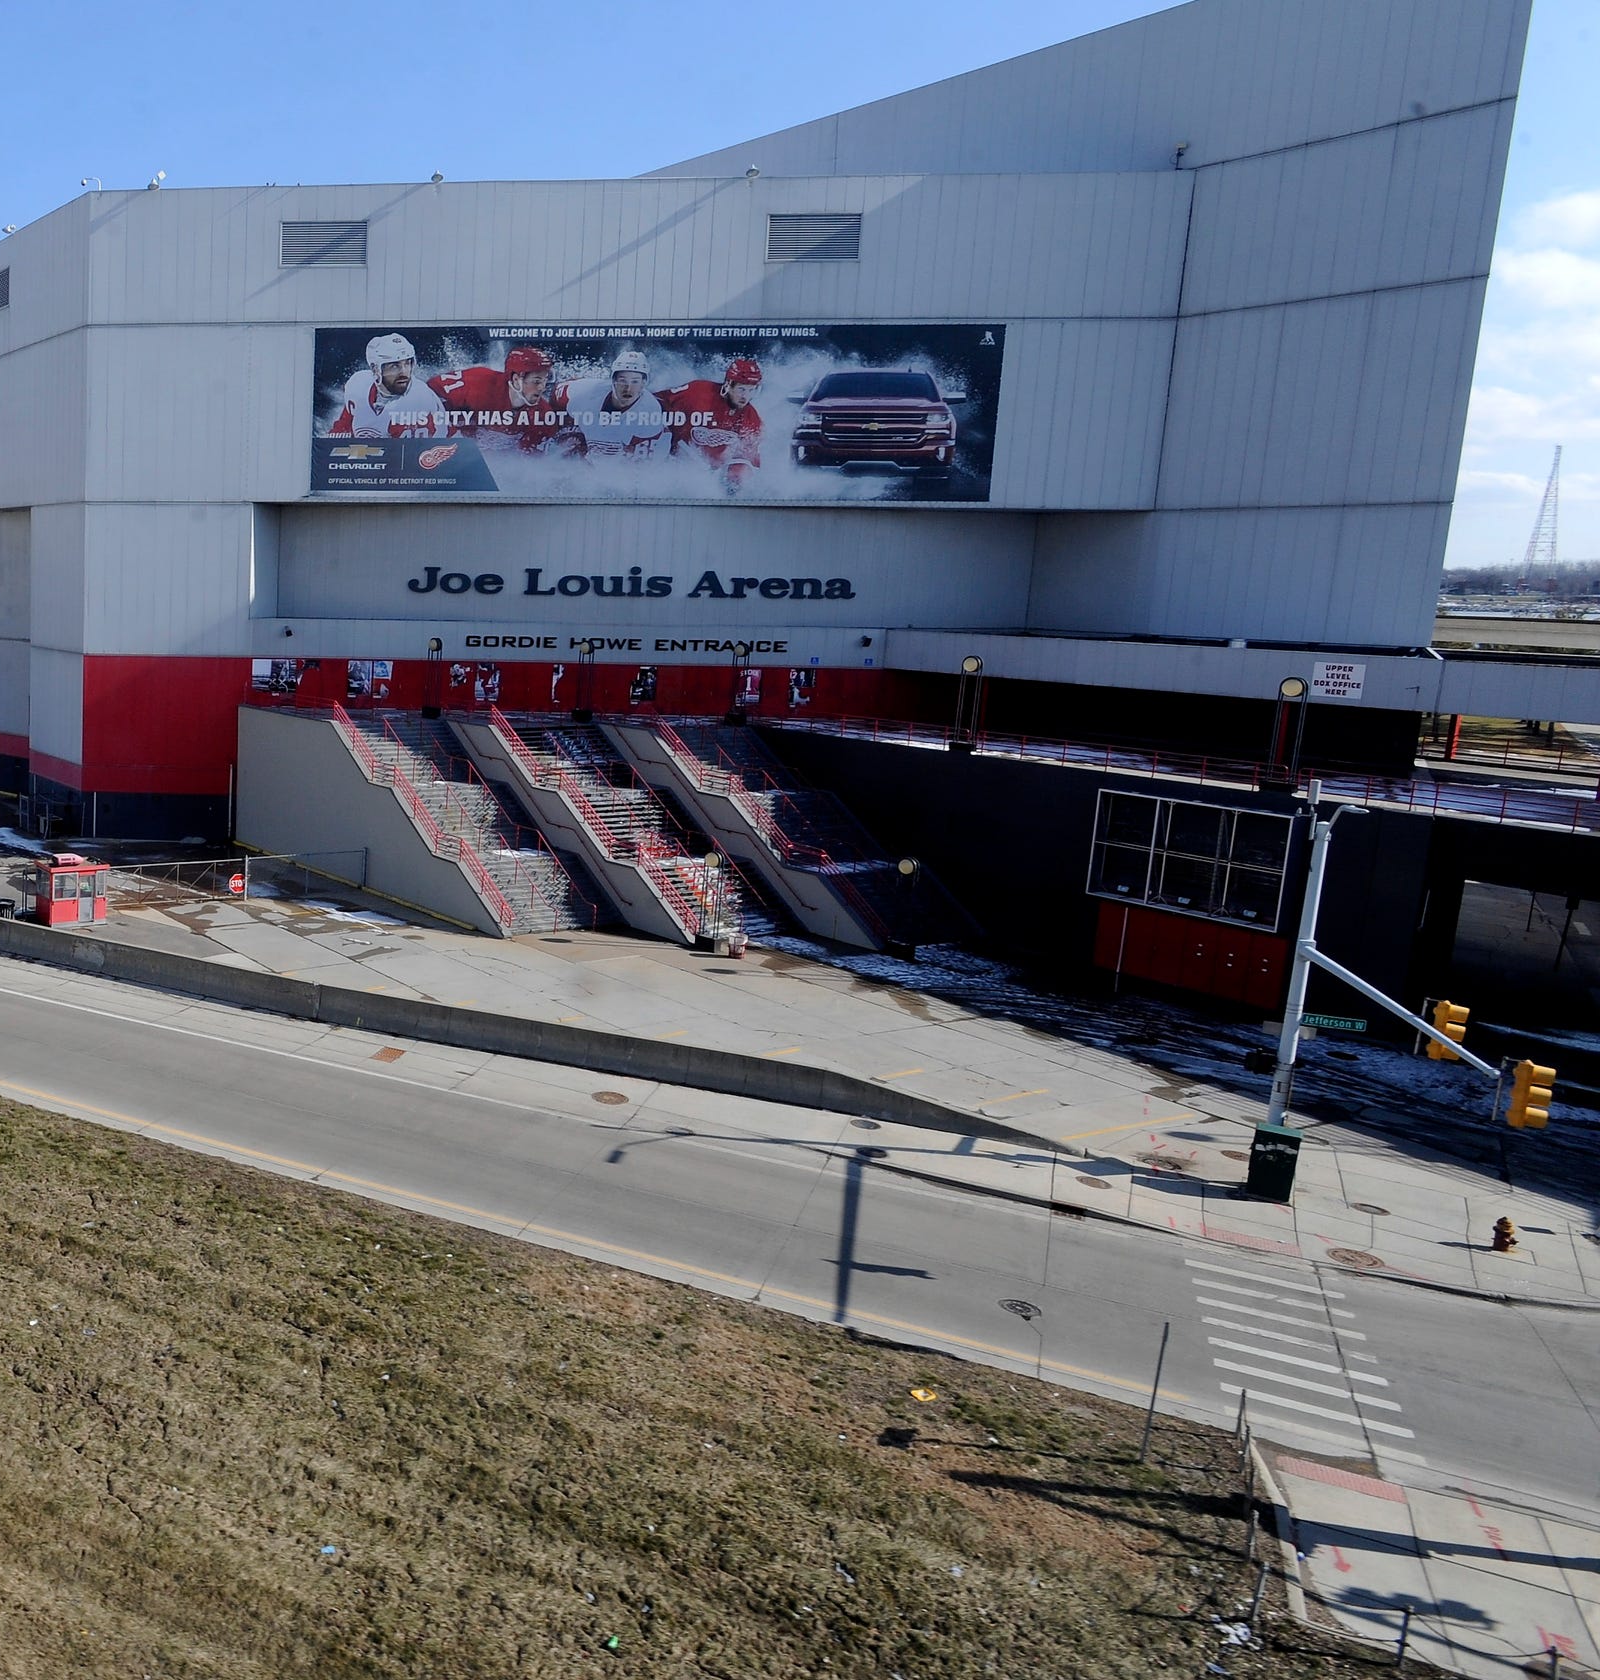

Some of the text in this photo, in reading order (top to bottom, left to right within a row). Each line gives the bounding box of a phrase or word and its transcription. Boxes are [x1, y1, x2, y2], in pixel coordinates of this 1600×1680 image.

[489, 328, 818, 338] WELCOME TO JOE LOUIS ARENA. HOME OF THE DETROIT RED WINGS.
[389, 411, 718, 427] THIS CITY HAS A LOT TO BE PROUD OF.
[408, 566, 856, 600] Joe Louis Arena
[466, 635, 788, 653] GORDIE HOWE ENTRANCE
[1325, 664, 1354, 672] UPPER
[231, 880, 244, 888] STO
[1304, 1015, 1364, 1030] Jefferson W
